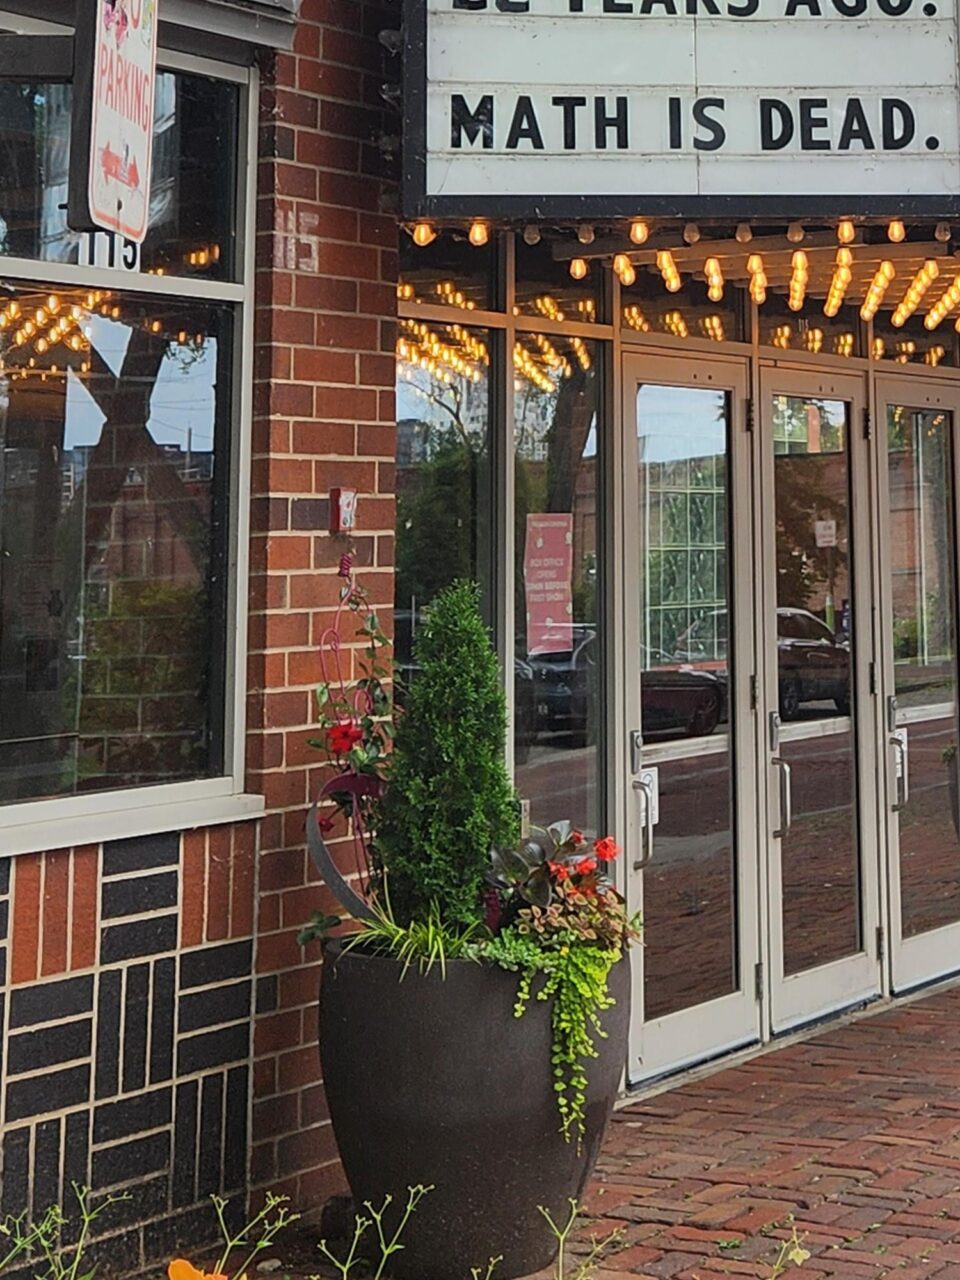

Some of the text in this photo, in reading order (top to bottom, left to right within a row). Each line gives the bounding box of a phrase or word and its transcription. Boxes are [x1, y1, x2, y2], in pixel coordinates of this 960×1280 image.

[98, 41, 150, 133] PARKING
[450, 93, 940, 152] MATH IS DEAD.
